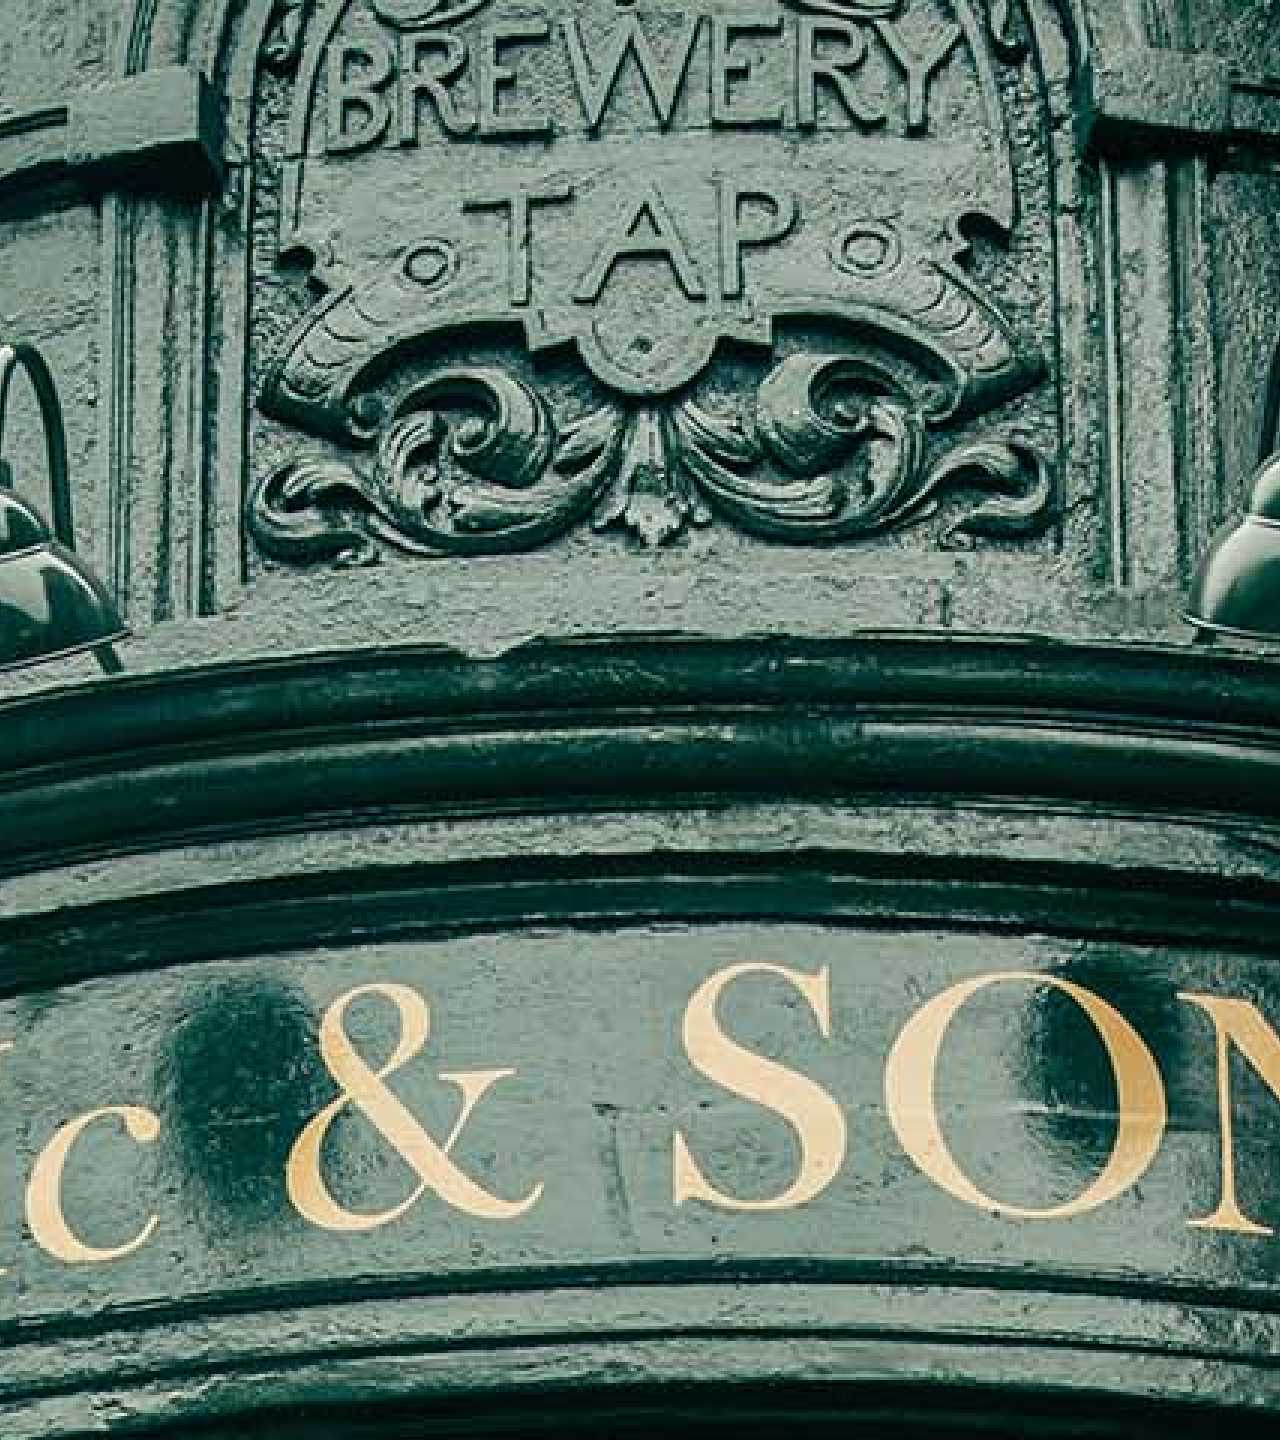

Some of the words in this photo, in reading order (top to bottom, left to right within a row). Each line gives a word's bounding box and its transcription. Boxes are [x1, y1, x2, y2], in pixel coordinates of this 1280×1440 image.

[323, 13, 966, 158] BREWERY
[461, 184, 802, 306] TAP
[286, 982, 544, 1231] &
